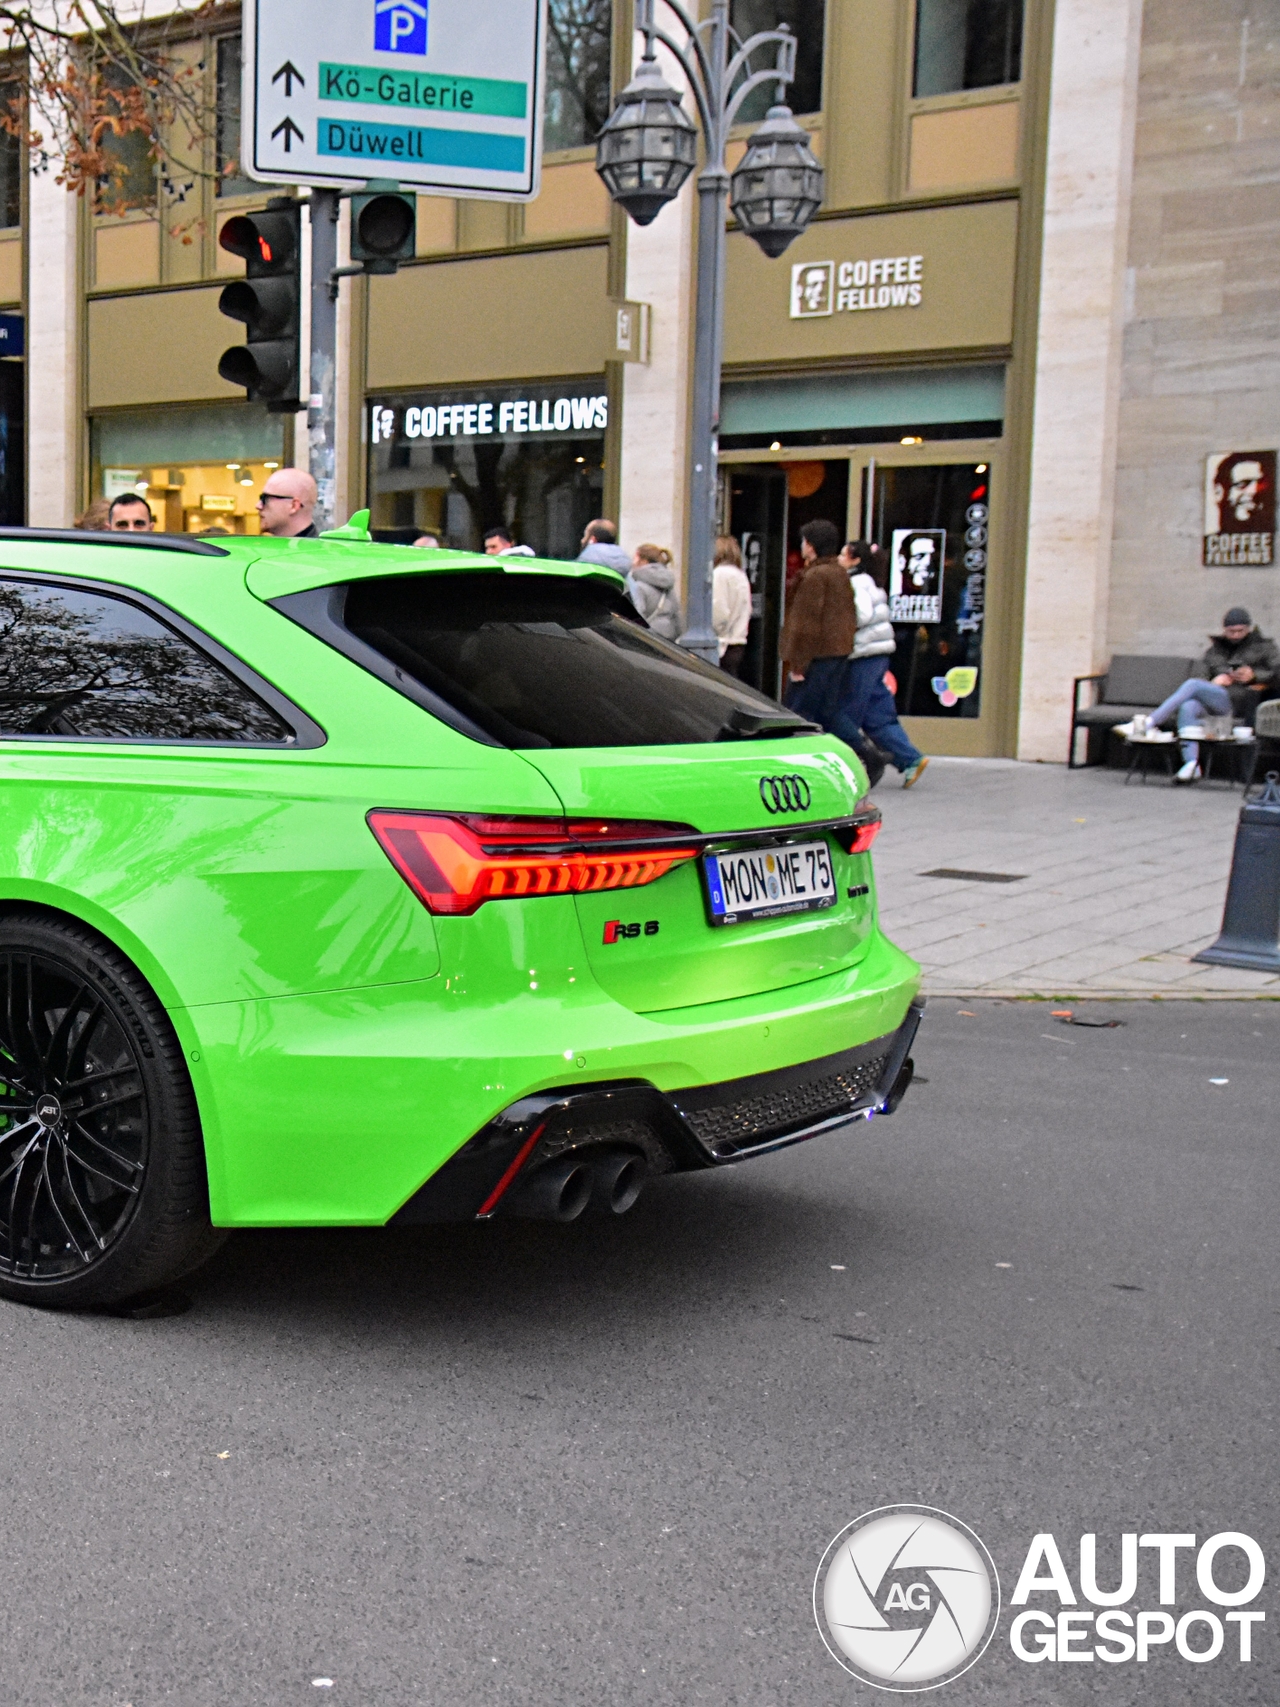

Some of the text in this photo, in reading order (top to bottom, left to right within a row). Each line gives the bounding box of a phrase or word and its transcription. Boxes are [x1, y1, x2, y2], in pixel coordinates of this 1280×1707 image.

[390, 9, 415, 50] P
[326, 68, 474, 109] Kö-Galerie
[328, 124, 424, 158] Düwell
[838, 255, 923, 288] COFFEE
[837, 283, 922, 312] FELLOWS
[405, 396, 608, 438] COFFEE FELLOWS
[1207, 532, 1272, 552] COFFEE
[1206, 551, 1271, 565] FELLOWS
[892, 595, 939, 610] COFFEE
[720, 849, 830, 905] MON ME 75
[613, 920, 659, 940] RS 6
[40, 1105, 58, 1115] ABT
